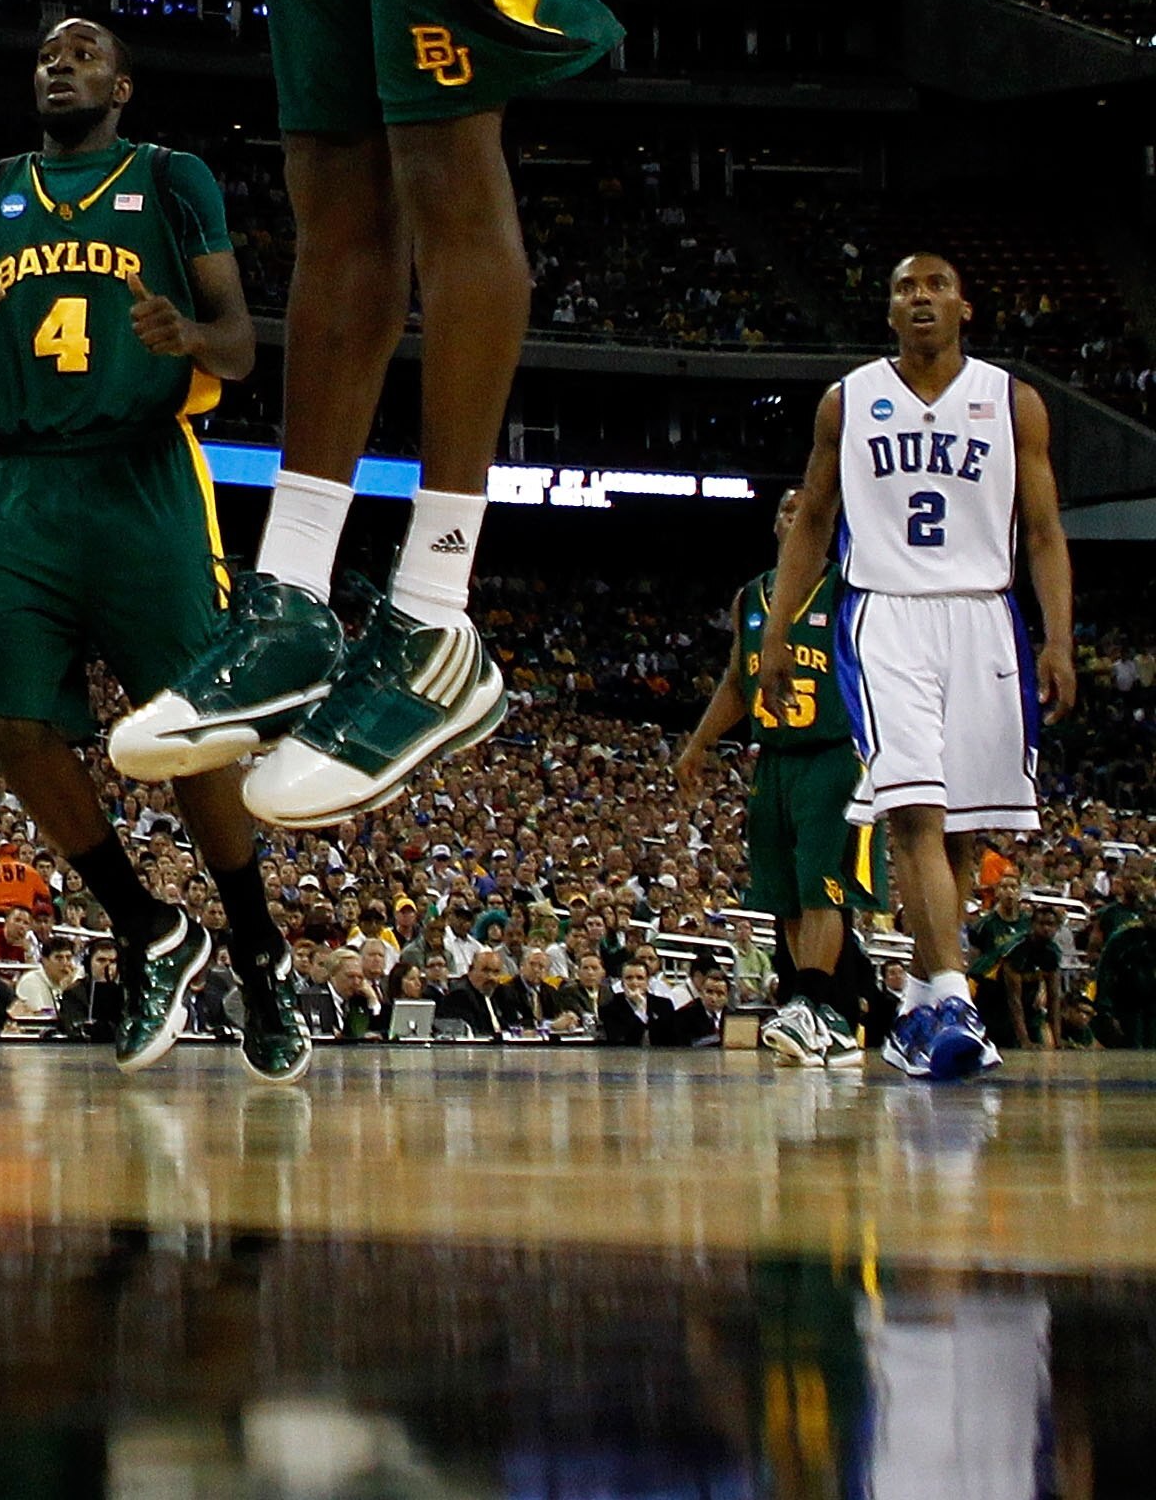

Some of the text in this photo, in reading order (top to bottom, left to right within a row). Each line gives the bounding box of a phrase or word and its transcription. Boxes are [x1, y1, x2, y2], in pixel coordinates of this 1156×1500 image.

[34, 297, 90, 372] 4
[867, 432, 991, 482] DUKE
[907, 491, 947, 547] 2
